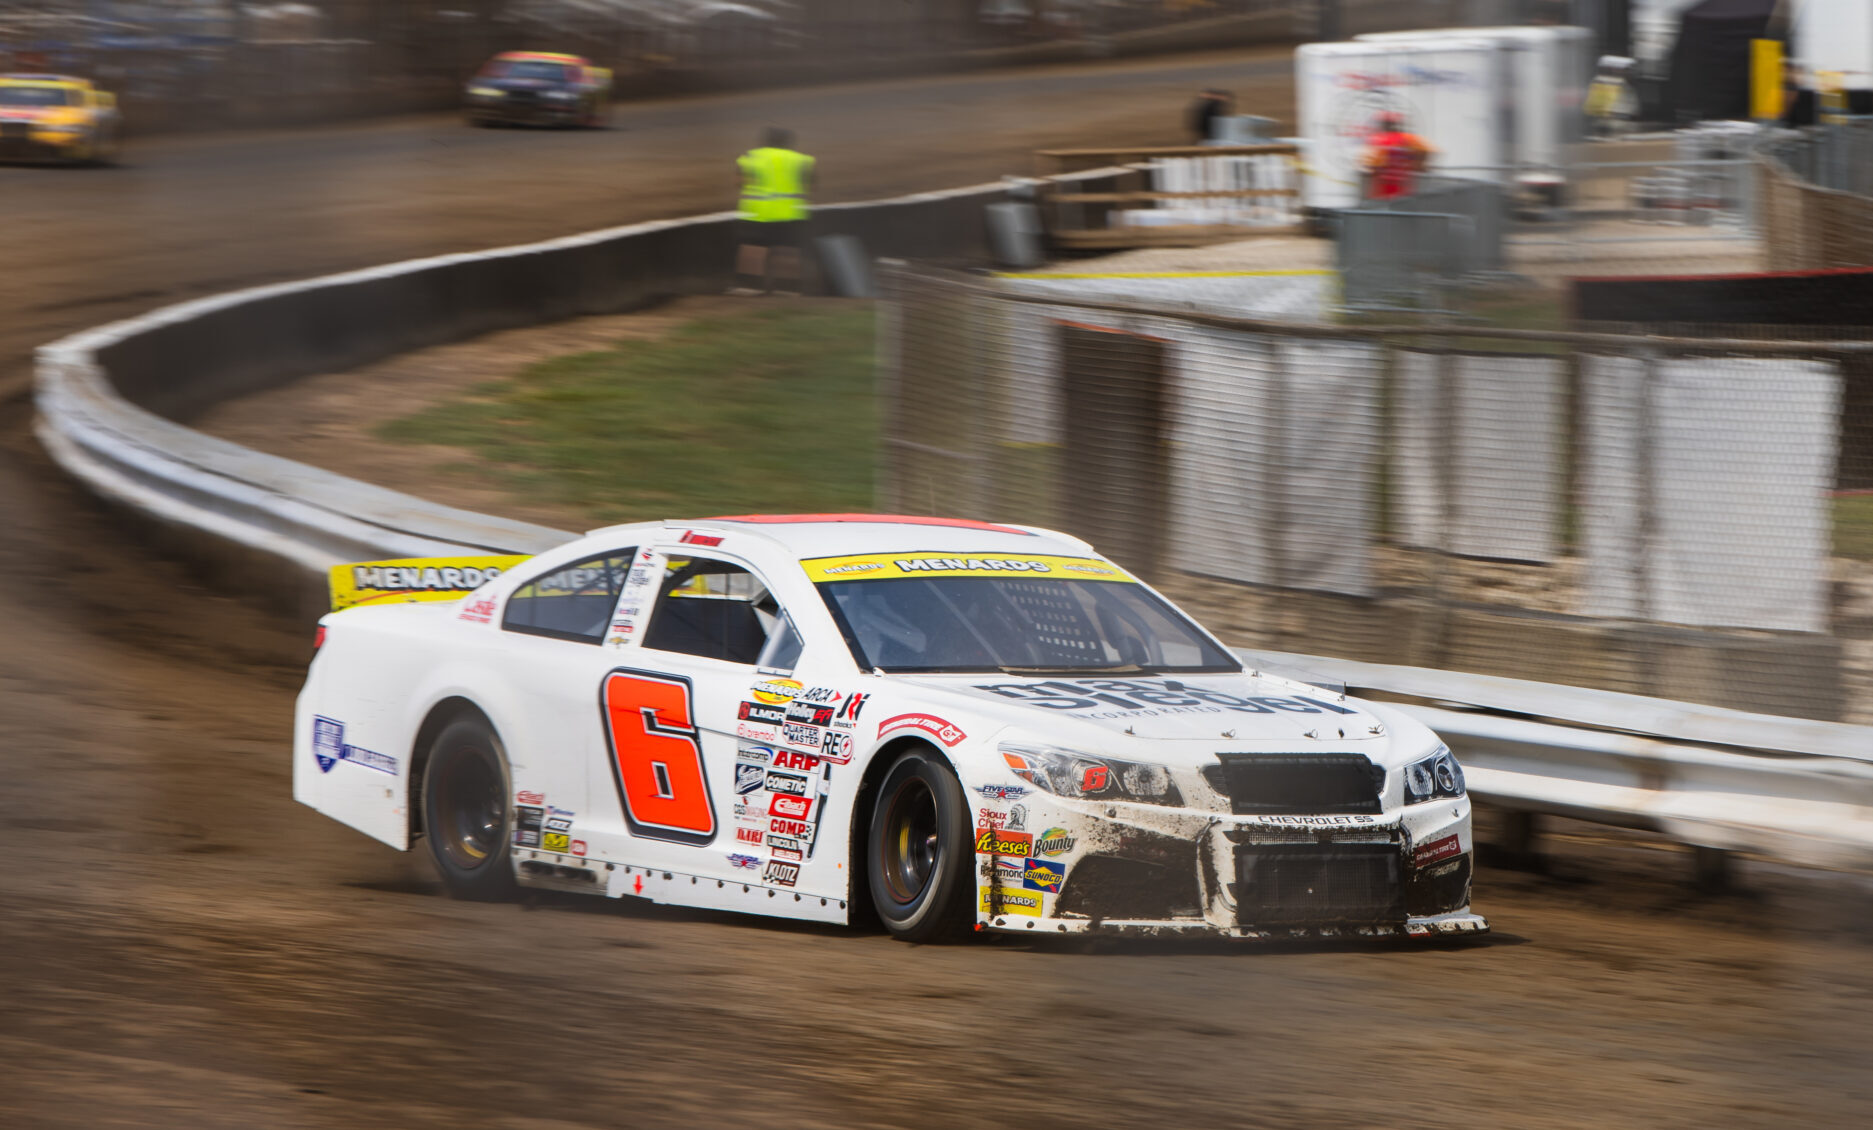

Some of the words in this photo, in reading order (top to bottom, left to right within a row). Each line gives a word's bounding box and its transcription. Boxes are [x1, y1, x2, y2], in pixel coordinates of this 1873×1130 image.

[824, 563, 885, 574] MENARDS
[894, 559, 1051, 573] MENARDS
[803, 687, 833, 702] ARCA
[786, 702, 816, 723] Holley
[1067, 706, 1222, 720] INCORPORATED
[783, 723, 819, 736] QUARTER
[788, 732, 819, 745] MASTER
[598, 666, 718, 848] 6
[773, 751, 820, 771] ARP
[766, 776, 806, 793] COMETIC
[1082, 765, 1108, 791] 6
[983, 785, 1003, 793] FIVE
[1004, 786, 1023, 794] STAR
[979, 808, 1007, 820] Sioux
[1258, 816, 1351, 825] CHEVROLET
[1354, 815, 1374, 823] SS
[770, 819, 806, 837] COMP
[978, 818, 1004, 829] Chief
[976, 831, 1030, 856] Reese's
[1033, 836, 1078, 858] Bounty
[766, 863, 798, 881] KLOTZ
[1026, 871, 1061, 883] SUNOCO
[984, 894, 1036, 907] MNARDS
